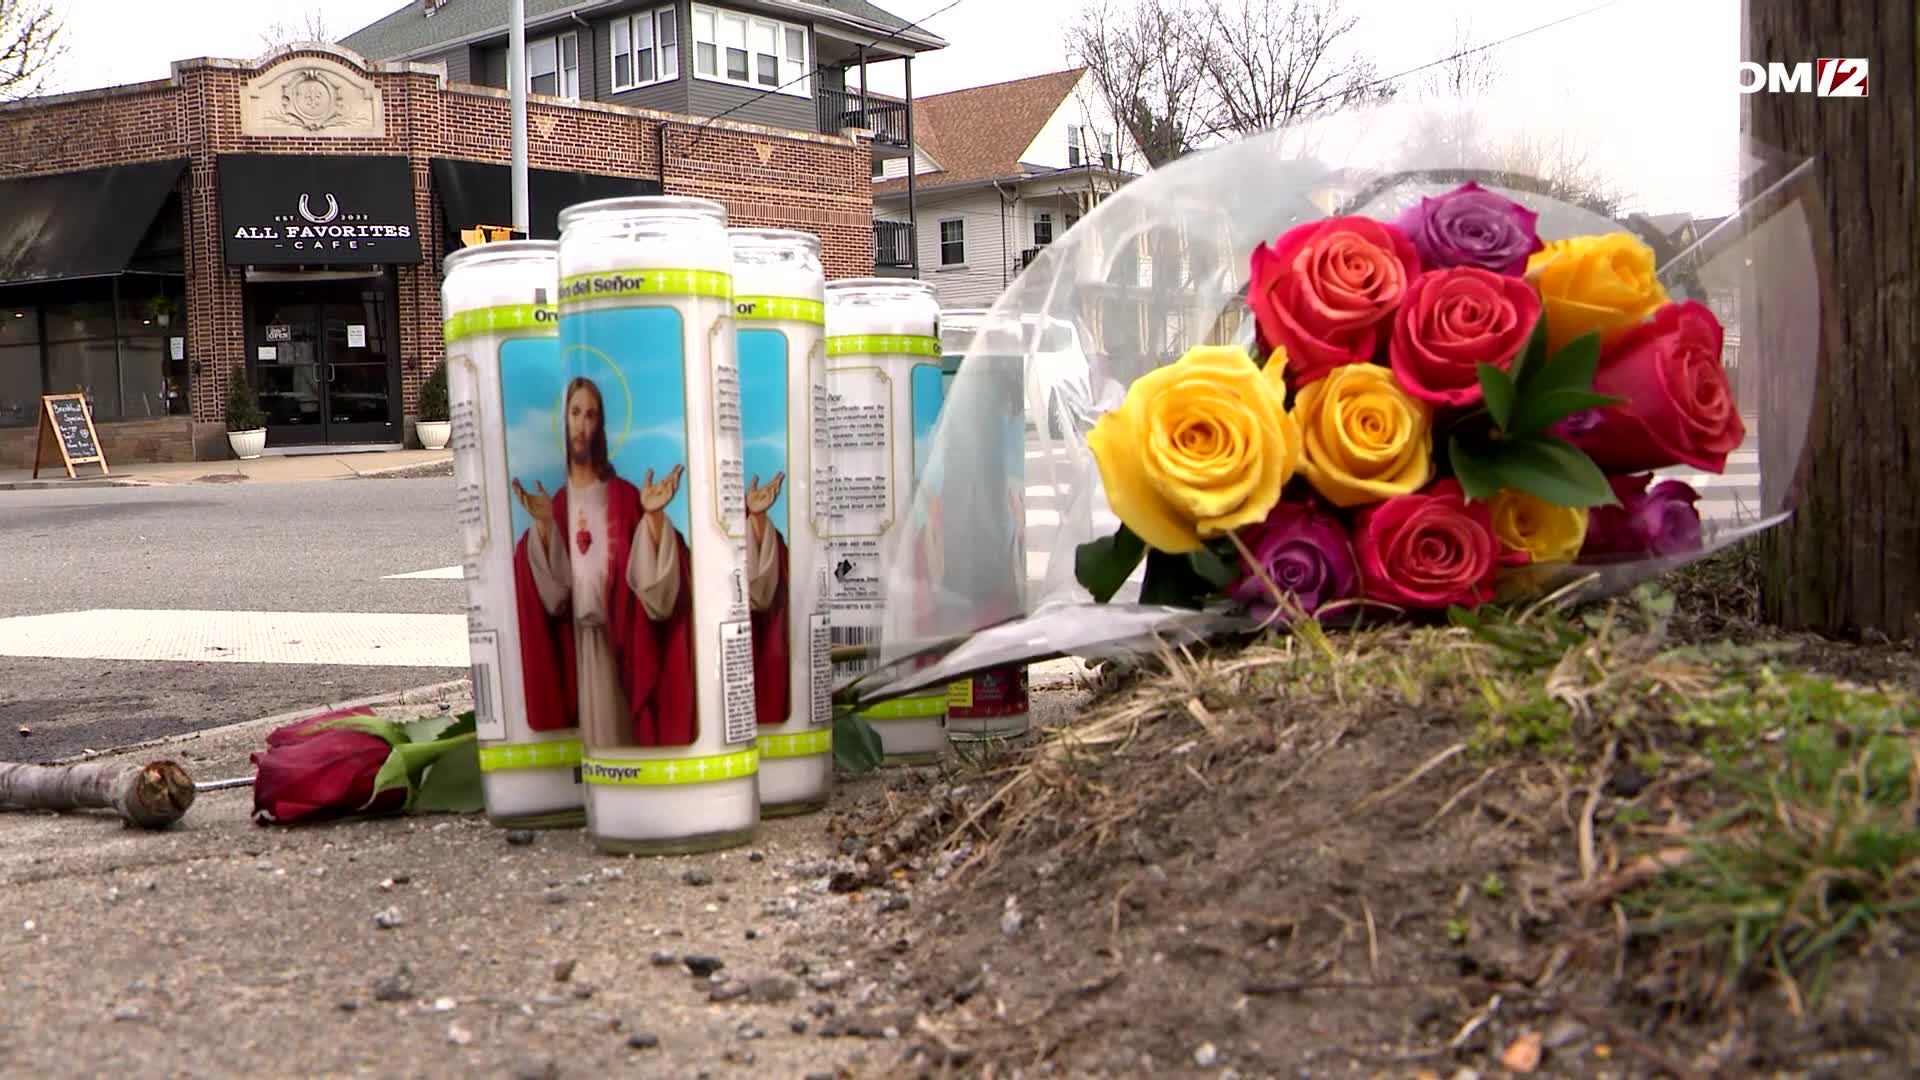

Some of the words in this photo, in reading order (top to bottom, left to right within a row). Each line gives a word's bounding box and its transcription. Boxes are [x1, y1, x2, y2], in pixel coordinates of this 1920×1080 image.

[234, 226, 279, 239] ALL
[285, 225, 411, 239] FAVORITES
[294, 240, 358, 250] CAFE
[572, 280, 591, 296] del
[595, 763, 642, 782] Prayer
